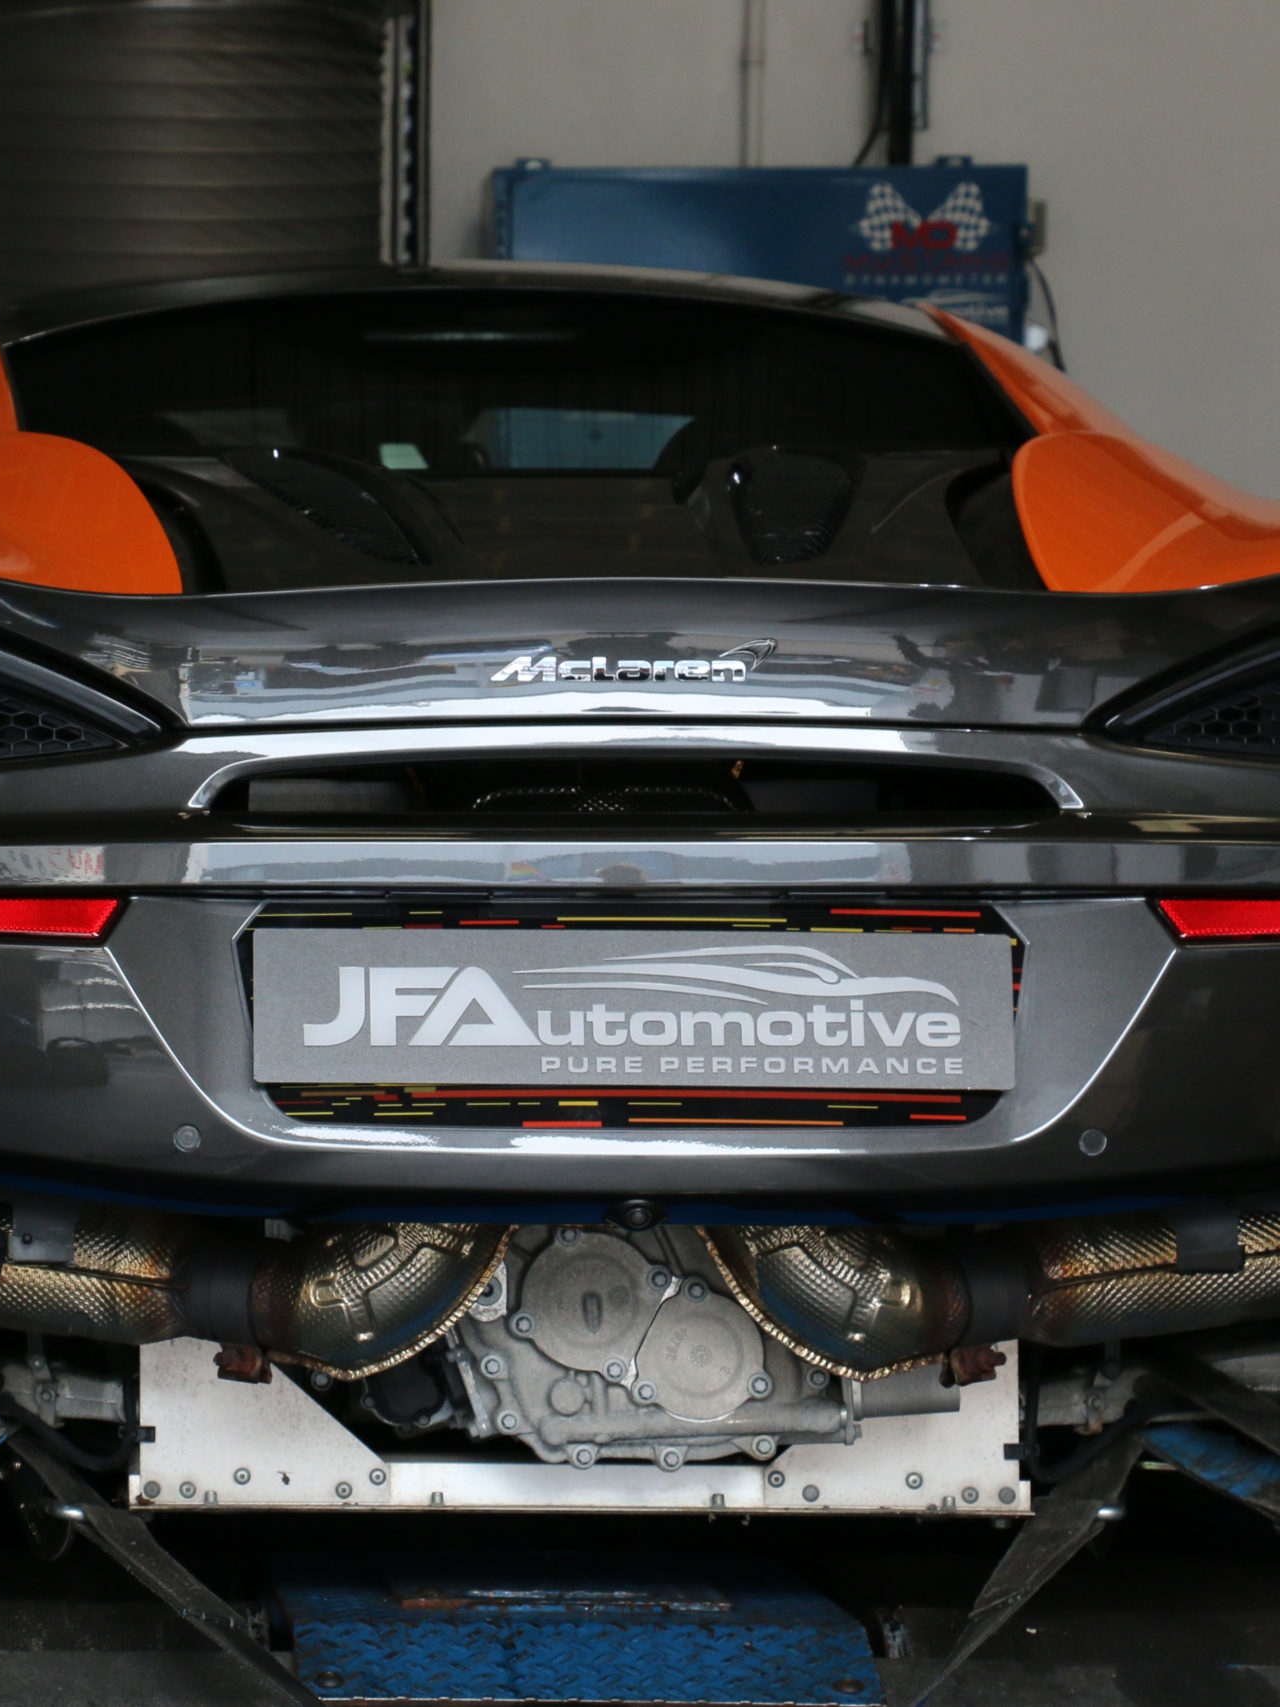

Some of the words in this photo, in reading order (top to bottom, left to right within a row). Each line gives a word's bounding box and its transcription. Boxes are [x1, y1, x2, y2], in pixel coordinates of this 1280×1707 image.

[892, 221, 959, 249] MD
[844, 252, 1009, 269] MUSTANG
[844, 273, 1009, 286] DYNAMOMETER
[489, 655, 747, 683] McLaren
[540, 1056, 643, 1075] PURE
[660, 1056, 965, 1076] PERFORMANCE
